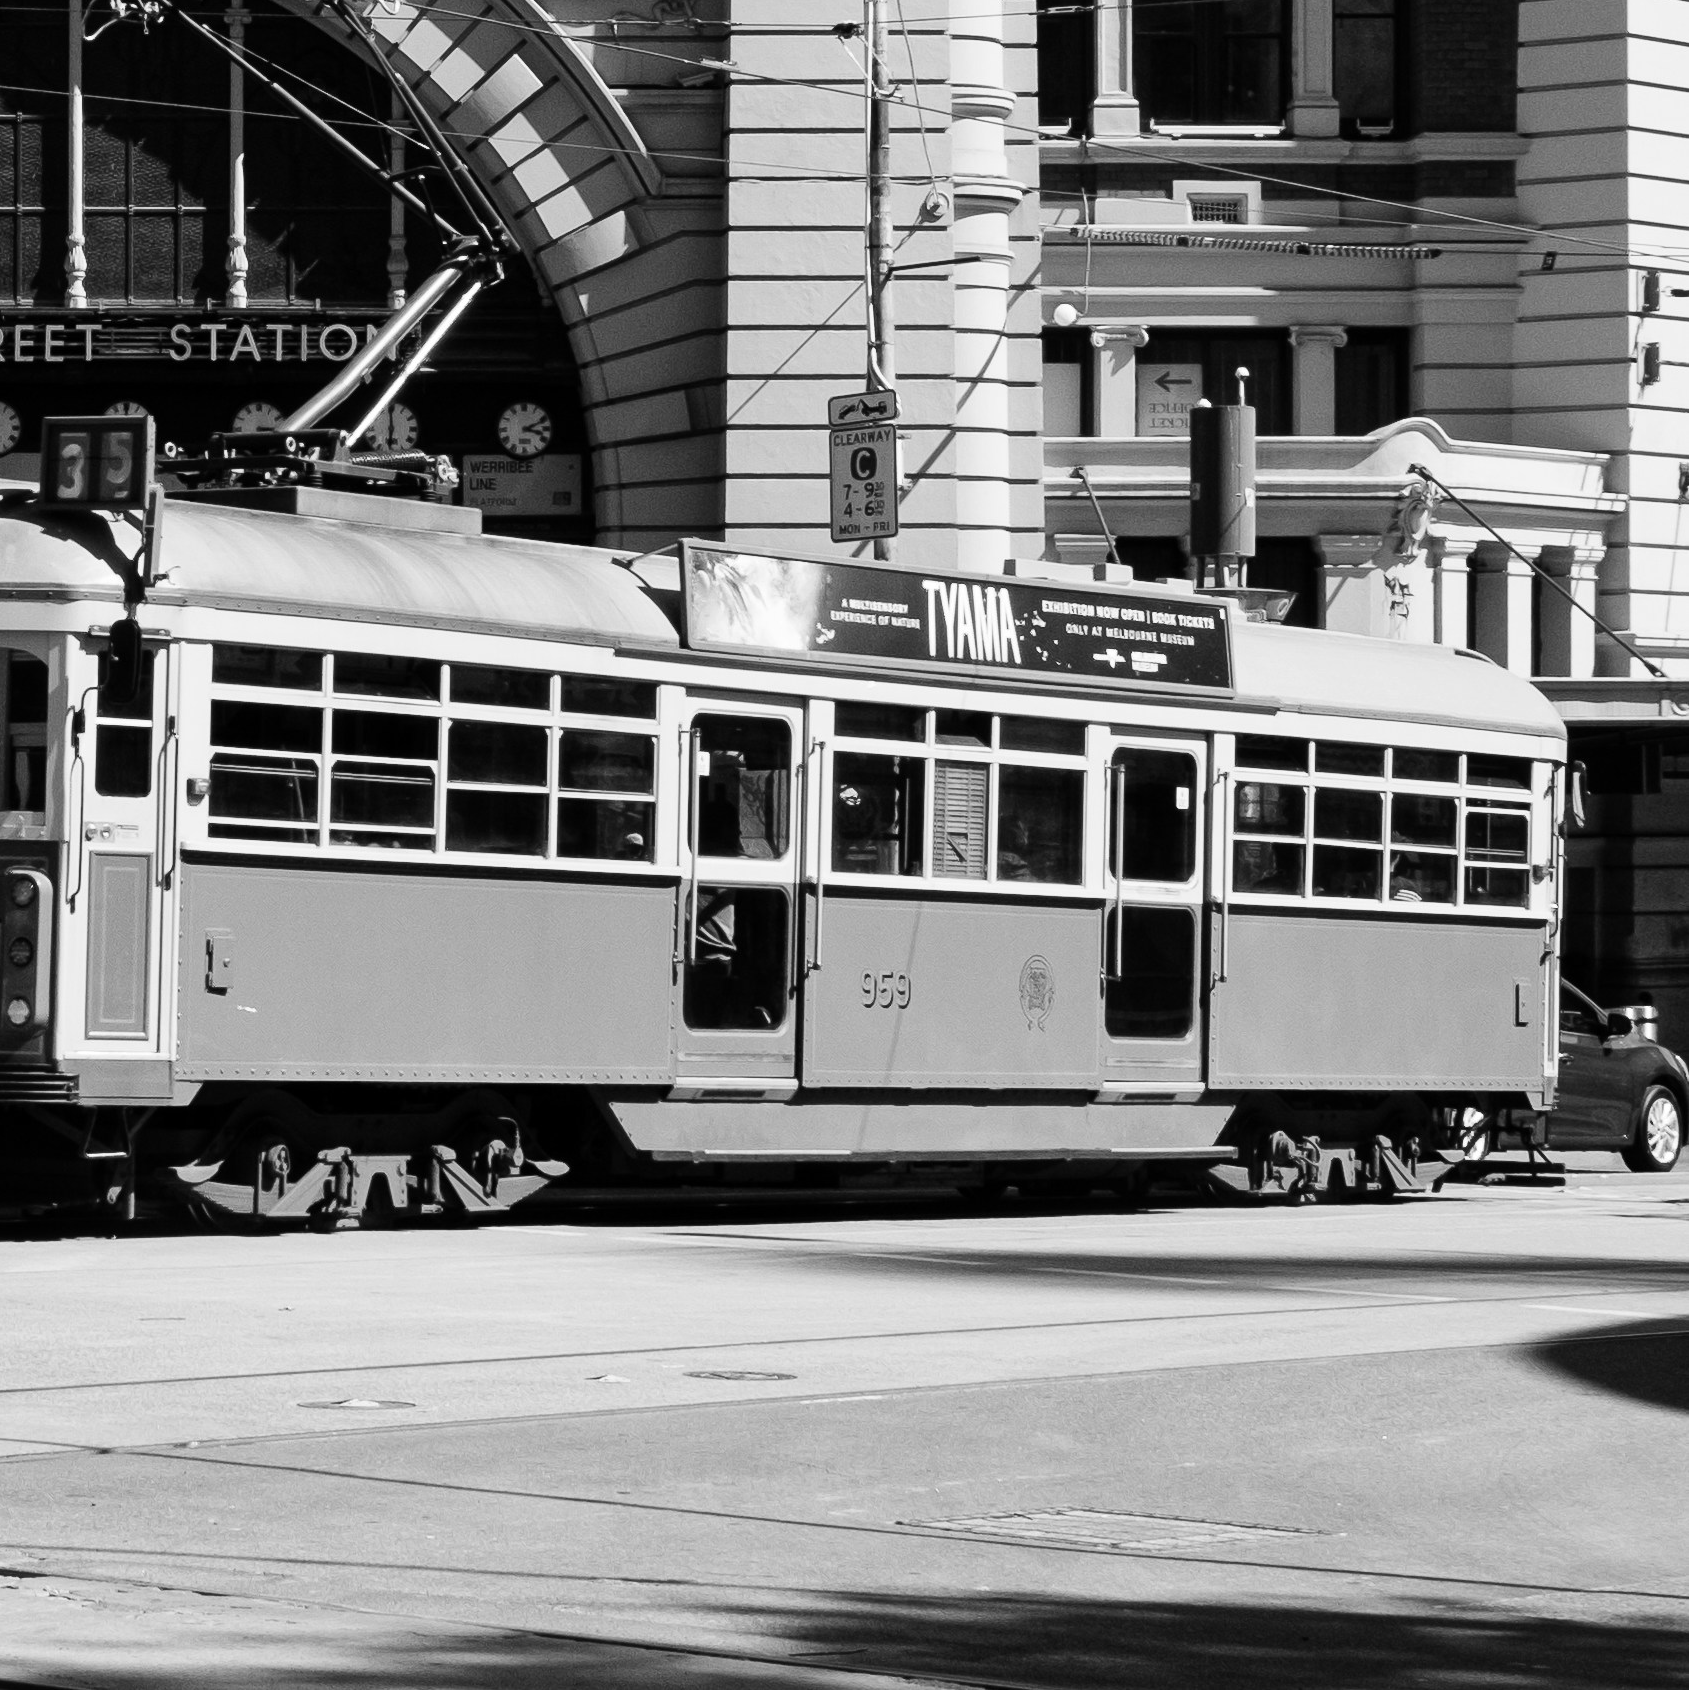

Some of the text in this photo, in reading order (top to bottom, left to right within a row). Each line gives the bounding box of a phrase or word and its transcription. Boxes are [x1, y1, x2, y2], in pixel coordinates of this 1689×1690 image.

[1150, 417, 1190, 428] ICKET
[833, 429, 892, 447] CLEARWAY
[57, 436, 132, 499] 35
[470, 460, 534, 473] WERRIBEE
[470, 478, 497, 491] LINE
[839, 524, 861, 534] MON
[873, 522, 890, 532] FRI
[921, 579, 1021, 664] TYAMA
[1042, 600, 1215, 629] EXHIBITION NOW OPEN BOOK TICKETS
[1066, 622, 1195, 646] ONLY AT MELBOURNE MUSEUM
[862, 970, 911, 1010] 959
